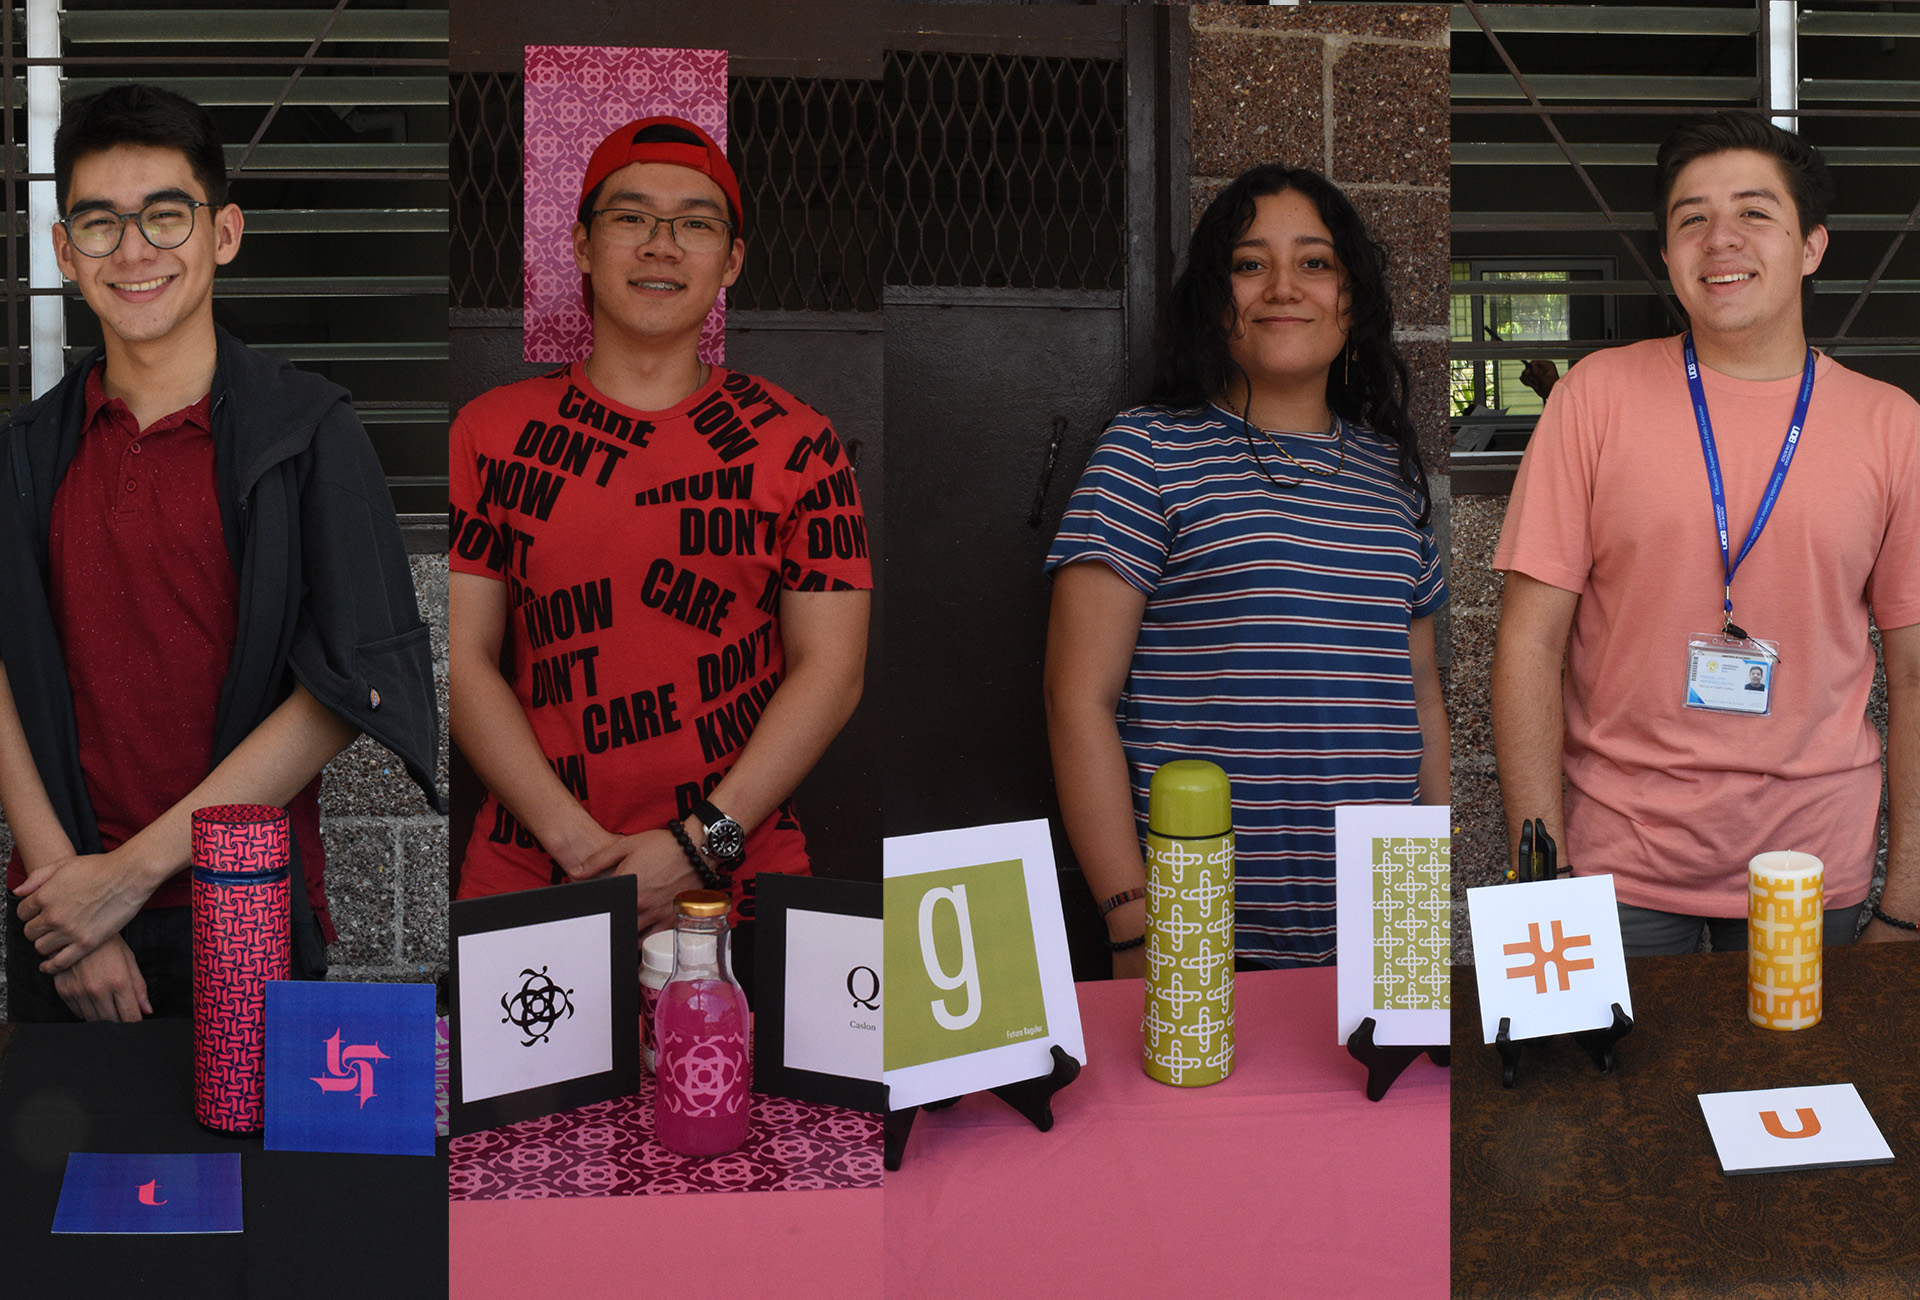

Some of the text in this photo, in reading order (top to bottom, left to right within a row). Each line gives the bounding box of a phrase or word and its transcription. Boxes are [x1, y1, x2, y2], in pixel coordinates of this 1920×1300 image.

[1687, 363, 1698, 380] UDB
[558, 384, 656, 448] CARE
[722, 372, 789, 429] ON'T
[513, 419, 628, 488] DON'T
[1788, 425, 1801, 444] UDB
[1708, 448, 1716, 470] Superior
[635, 462, 754, 506] NOW
[1712, 469, 1721, 496] Educación
[1769, 472, 1783, 497] Educación
[1761, 496, 1774, 517] Superior
[680, 507, 780, 557] DON'T
[1720, 530, 1728, 550] UDB
[522, 578, 613, 650] KNOW
[639, 558, 737, 647] CARE
[531, 646, 600, 709] DON'T
[697, 619, 772, 703] DON'T
[582, 683, 682, 754] CARE
[917, 884, 982, 1031] g
[846, 965, 881, 1011] Q
[849, 1019, 877, 1031] Caslon
[134, 1178, 168, 1206] t
